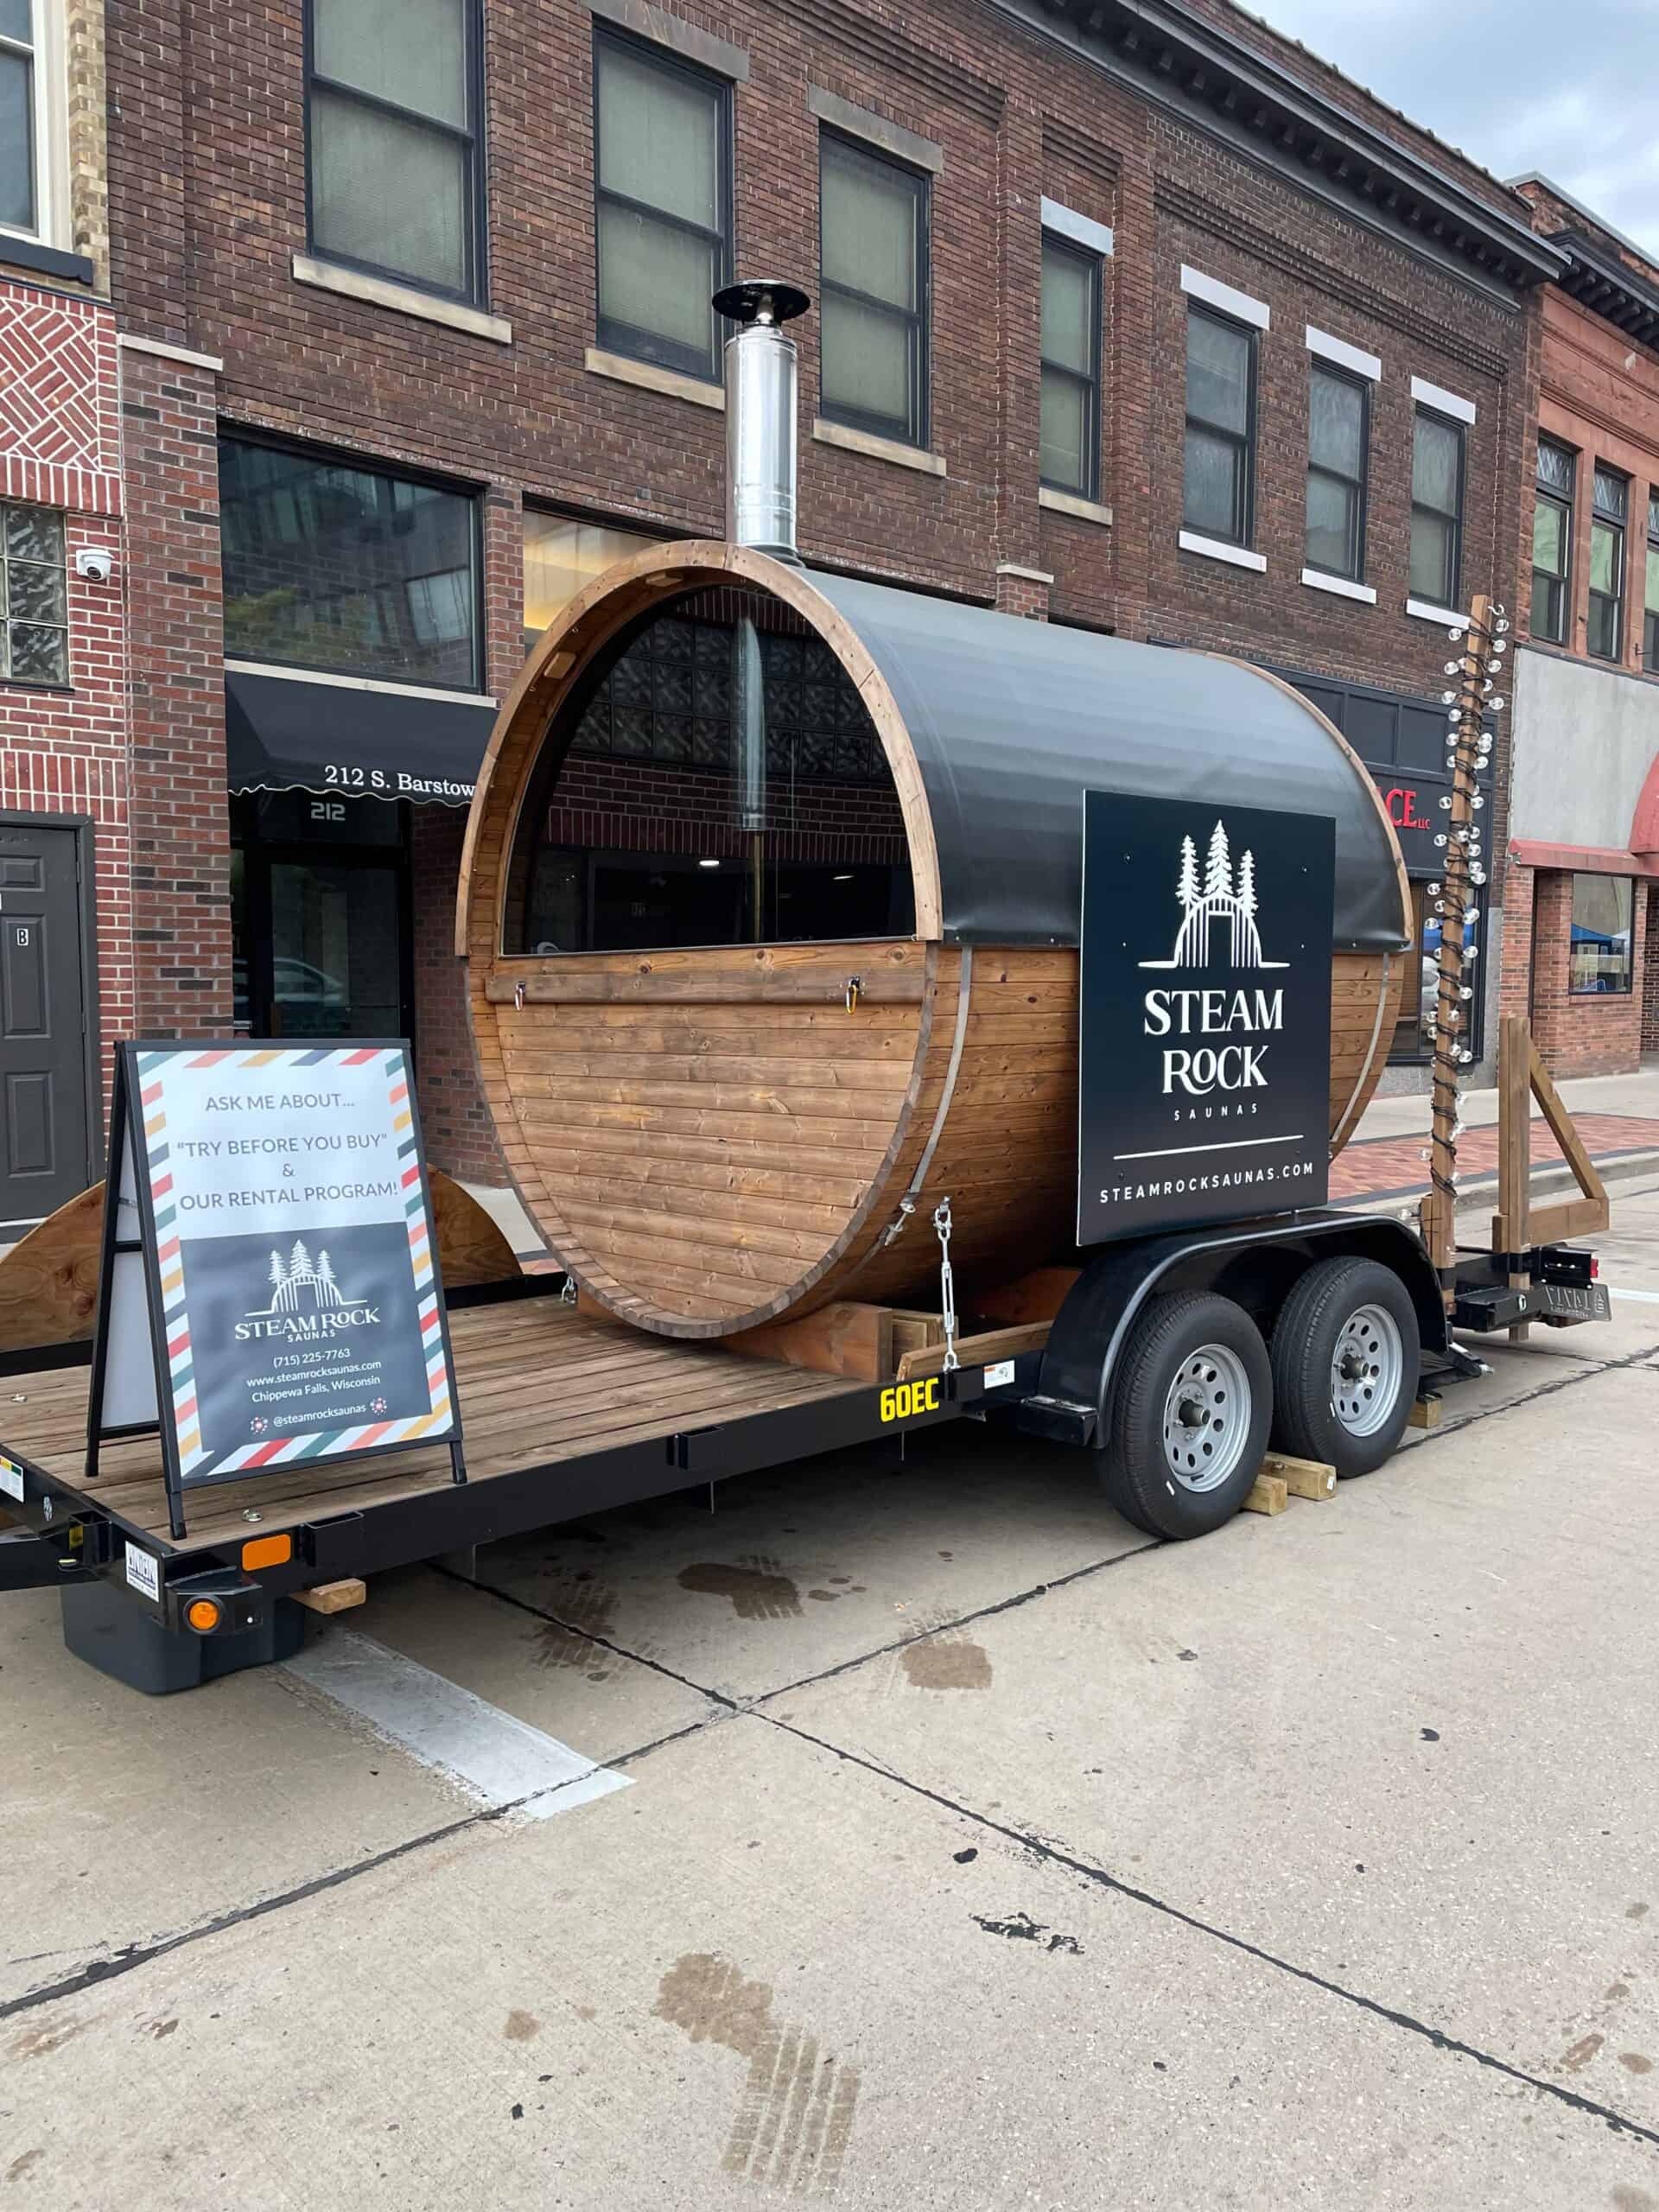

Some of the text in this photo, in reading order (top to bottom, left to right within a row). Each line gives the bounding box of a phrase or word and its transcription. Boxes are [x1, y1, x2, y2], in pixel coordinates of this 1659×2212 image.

[325, 766, 476, 797] 212 S. Barstow
[310, 802, 346, 821] 212
[18, 929, 27, 944] B
[1143, 988, 1284, 1036] STEAM
[1162, 1045, 1269, 1095] ROCK
[206, 1093, 355, 1111] ASK ME ABOUT...
[1174, 1103, 1258, 1121] SAUNAS
[227, 1137, 298, 1155] BEFORE
[303, 1136, 340, 1151] YOU
[283, 1163, 295, 1177] &
[1100, 1161, 1314, 1204] STEAMROCKSAUNAS.COM
[180, 1181, 398, 1210] OUR RENTAL PROGRAM!
[234, 1307, 380, 1340] STEAM ROCK
[288, 1330, 335, 1343] SAUNAS
[273, 1348, 351, 1369] (715) 225-7763
[246, 1361, 381, 1387] www.steamrocksaunas.com
[251, 1376, 380, 1403] Chippewa Falls, Wisconsin
[880, 1377, 940, 1423] 60EC
[273, 1404, 366, 1427] @steamrocksaunas
